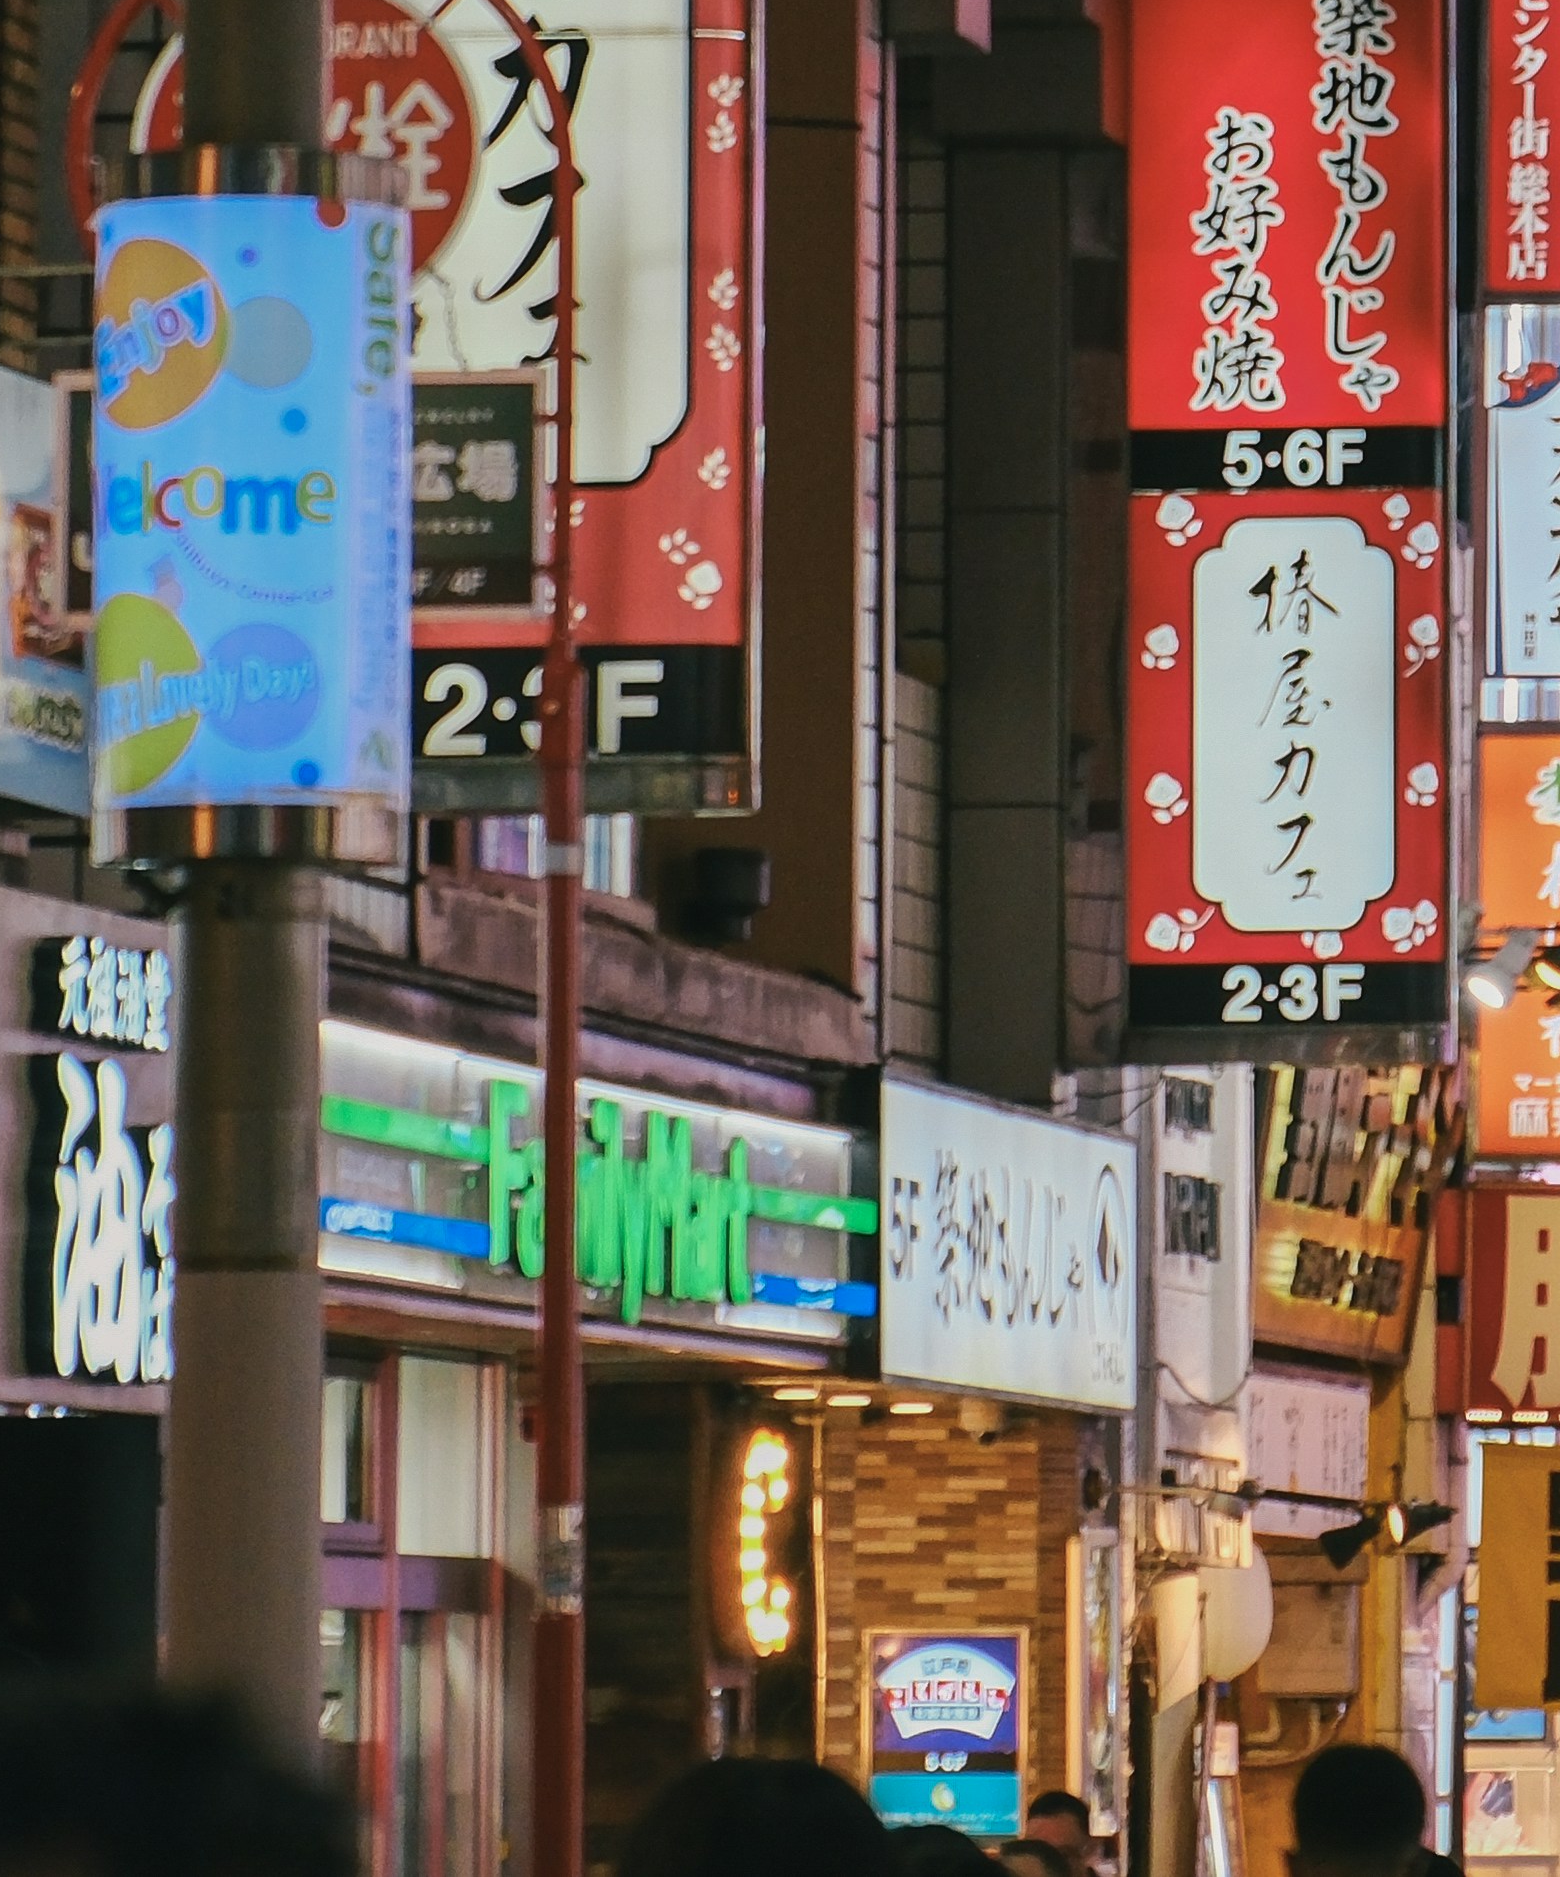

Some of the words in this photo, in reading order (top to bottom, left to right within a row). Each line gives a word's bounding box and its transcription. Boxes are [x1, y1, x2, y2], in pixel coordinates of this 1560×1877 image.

[1188, 105, 1286, 412] お好み焼
[1247, 549, 1340, 902] 椿屋カフェ
